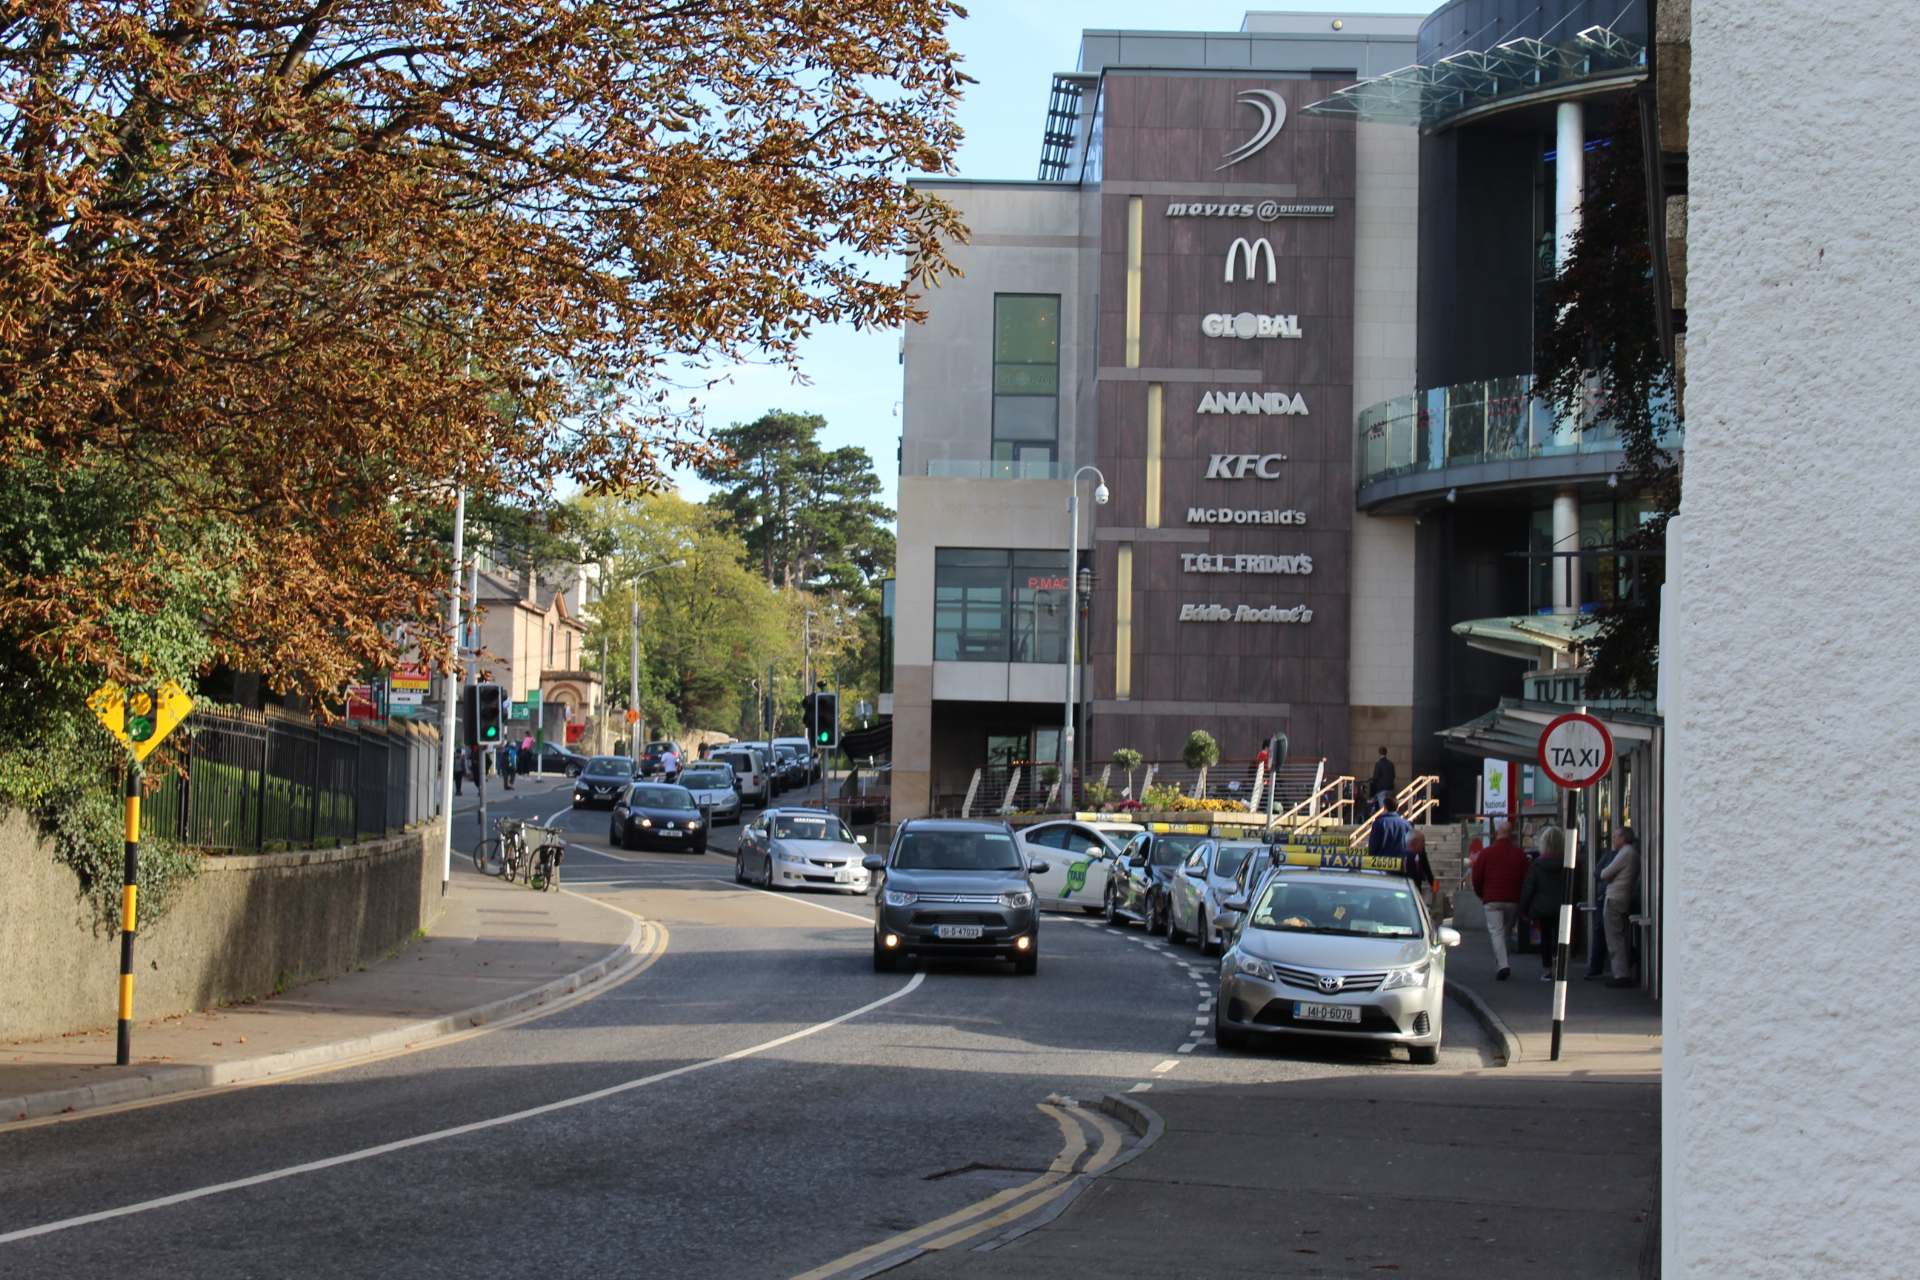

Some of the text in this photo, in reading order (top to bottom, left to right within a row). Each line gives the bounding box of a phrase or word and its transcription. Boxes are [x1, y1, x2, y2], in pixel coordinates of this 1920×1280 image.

[1202, 312, 1302, 339] GLOBAL
[1197, 391, 1309, 415] ANANDA
[1204, 453, 1283, 479] KFC
[1187, 508, 1306, 525] McDonald's
[1180, 604, 1313, 623] Eddie Rocket's
[1551, 748, 1599, 767] TAXI
[1485, 800, 1506, 808] National
[1097, 813, 1114, 821] TAXI
[1296, 835, 1320, 844] TAXI
[1308, 846, 1335, 854] TAXI
[1323, 854, 1360, 867] TAXI
[1069, 870, 1085, 881] TAXI
